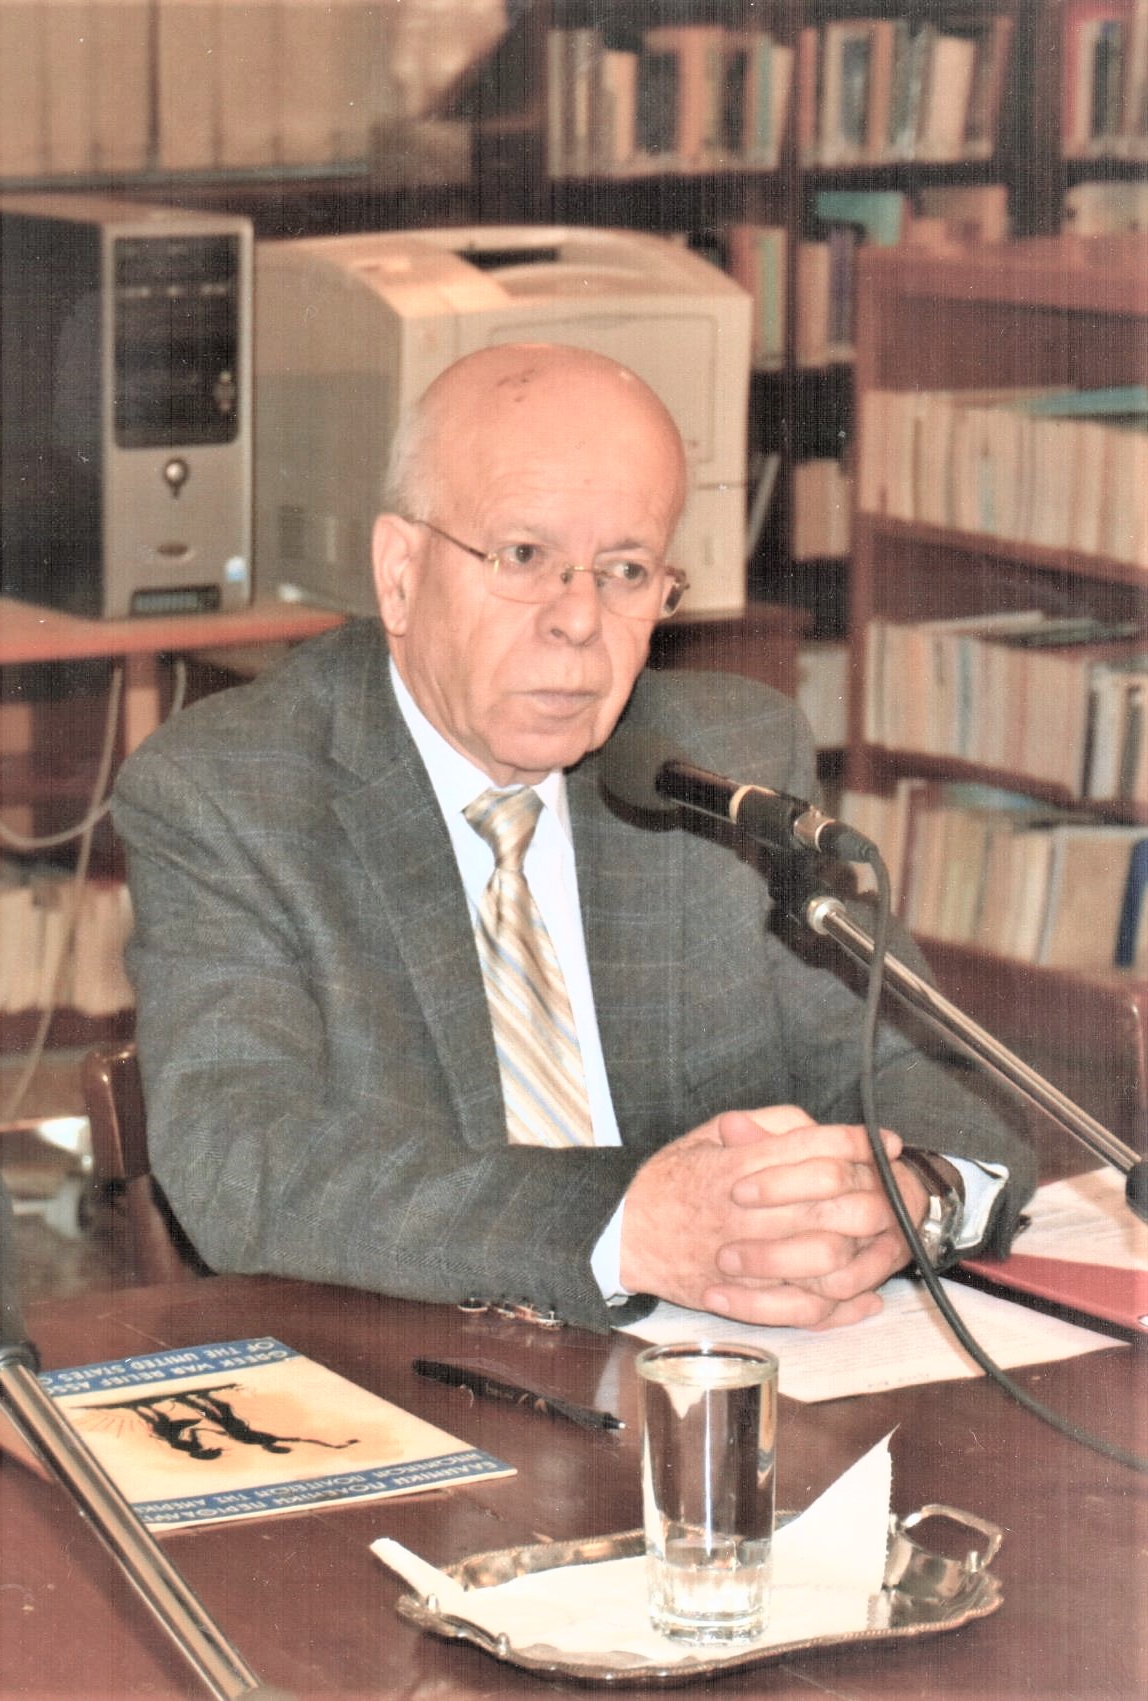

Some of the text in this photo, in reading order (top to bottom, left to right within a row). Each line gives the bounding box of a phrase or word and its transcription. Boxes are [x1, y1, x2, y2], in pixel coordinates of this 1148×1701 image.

[205, 1346, 242, 1359] THE
[246, 1341, 275, 1352] OF
[130, 1352, 201, 1371] UNITED
[220, 1350, 288, 1368] GREEK
[57, 1364, 127, 1381] STATES
[170, 1362, 215, 1375] WAR
[100, 1370, 166, 1387] RELIEF
